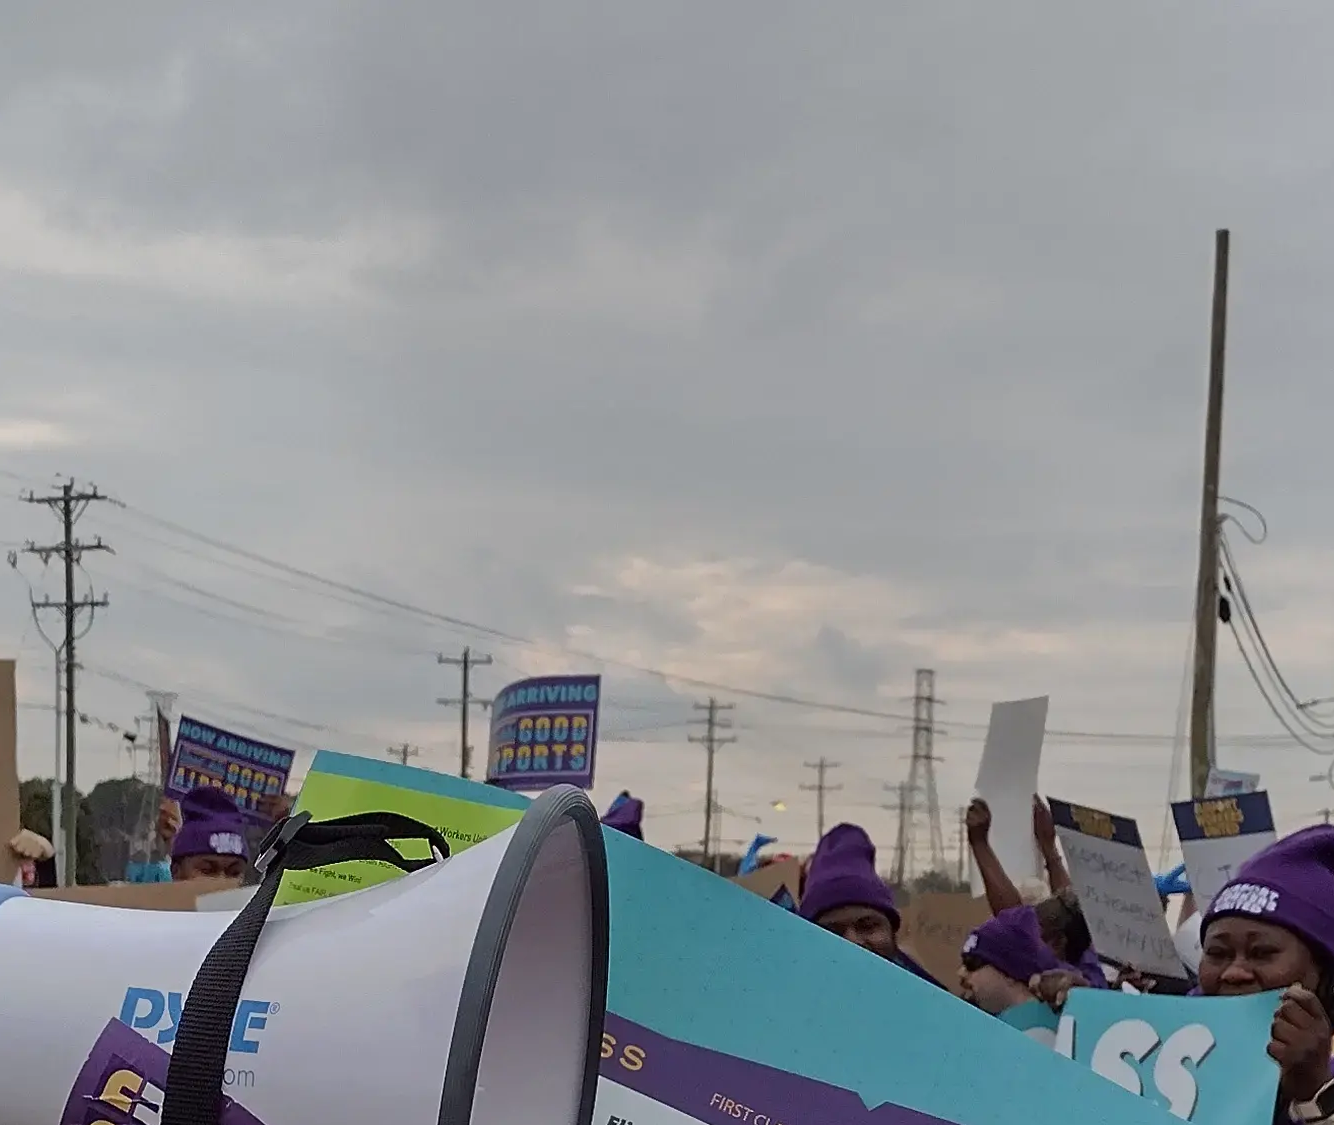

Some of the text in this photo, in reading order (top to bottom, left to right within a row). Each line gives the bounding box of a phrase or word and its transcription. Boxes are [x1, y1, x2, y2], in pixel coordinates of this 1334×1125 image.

[507, 683, 597, 707] ARRIVING
[518, 715, 588, 743] GOOD
[180, 721, 216, 743] NOW
[216, 737, 293, 768] ARRIVING
[226, 763, 280, 794] GOOD
[120, 987, 271, 1054] PYE
[709, 1093, 755, 1122] FIRST
